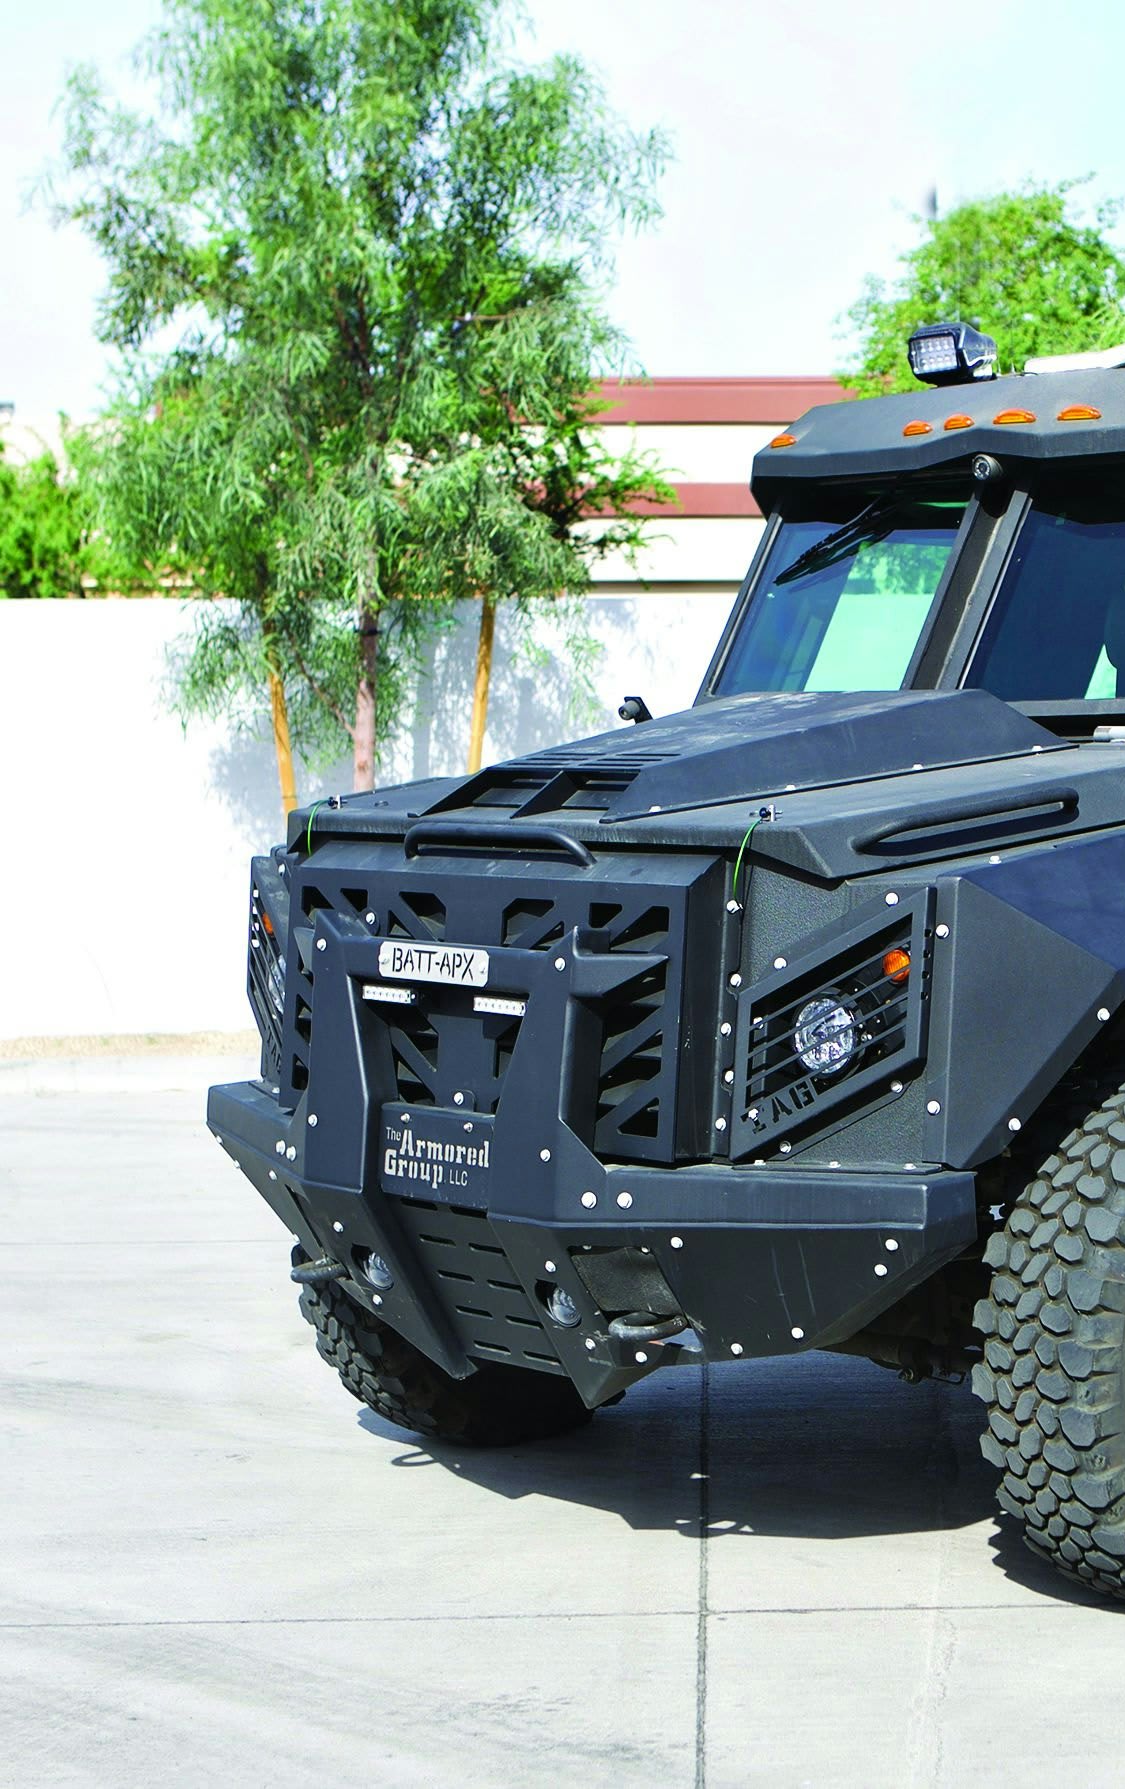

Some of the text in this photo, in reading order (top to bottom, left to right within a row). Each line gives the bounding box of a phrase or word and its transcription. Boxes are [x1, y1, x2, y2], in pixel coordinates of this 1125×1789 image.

[392, 947, 475, 981] BATT-APX
[740, 1081, 815, 1134] TAG
[385, 1127, 490, 1168] The Armored
[449, 1169, 468, 1186] LLC
